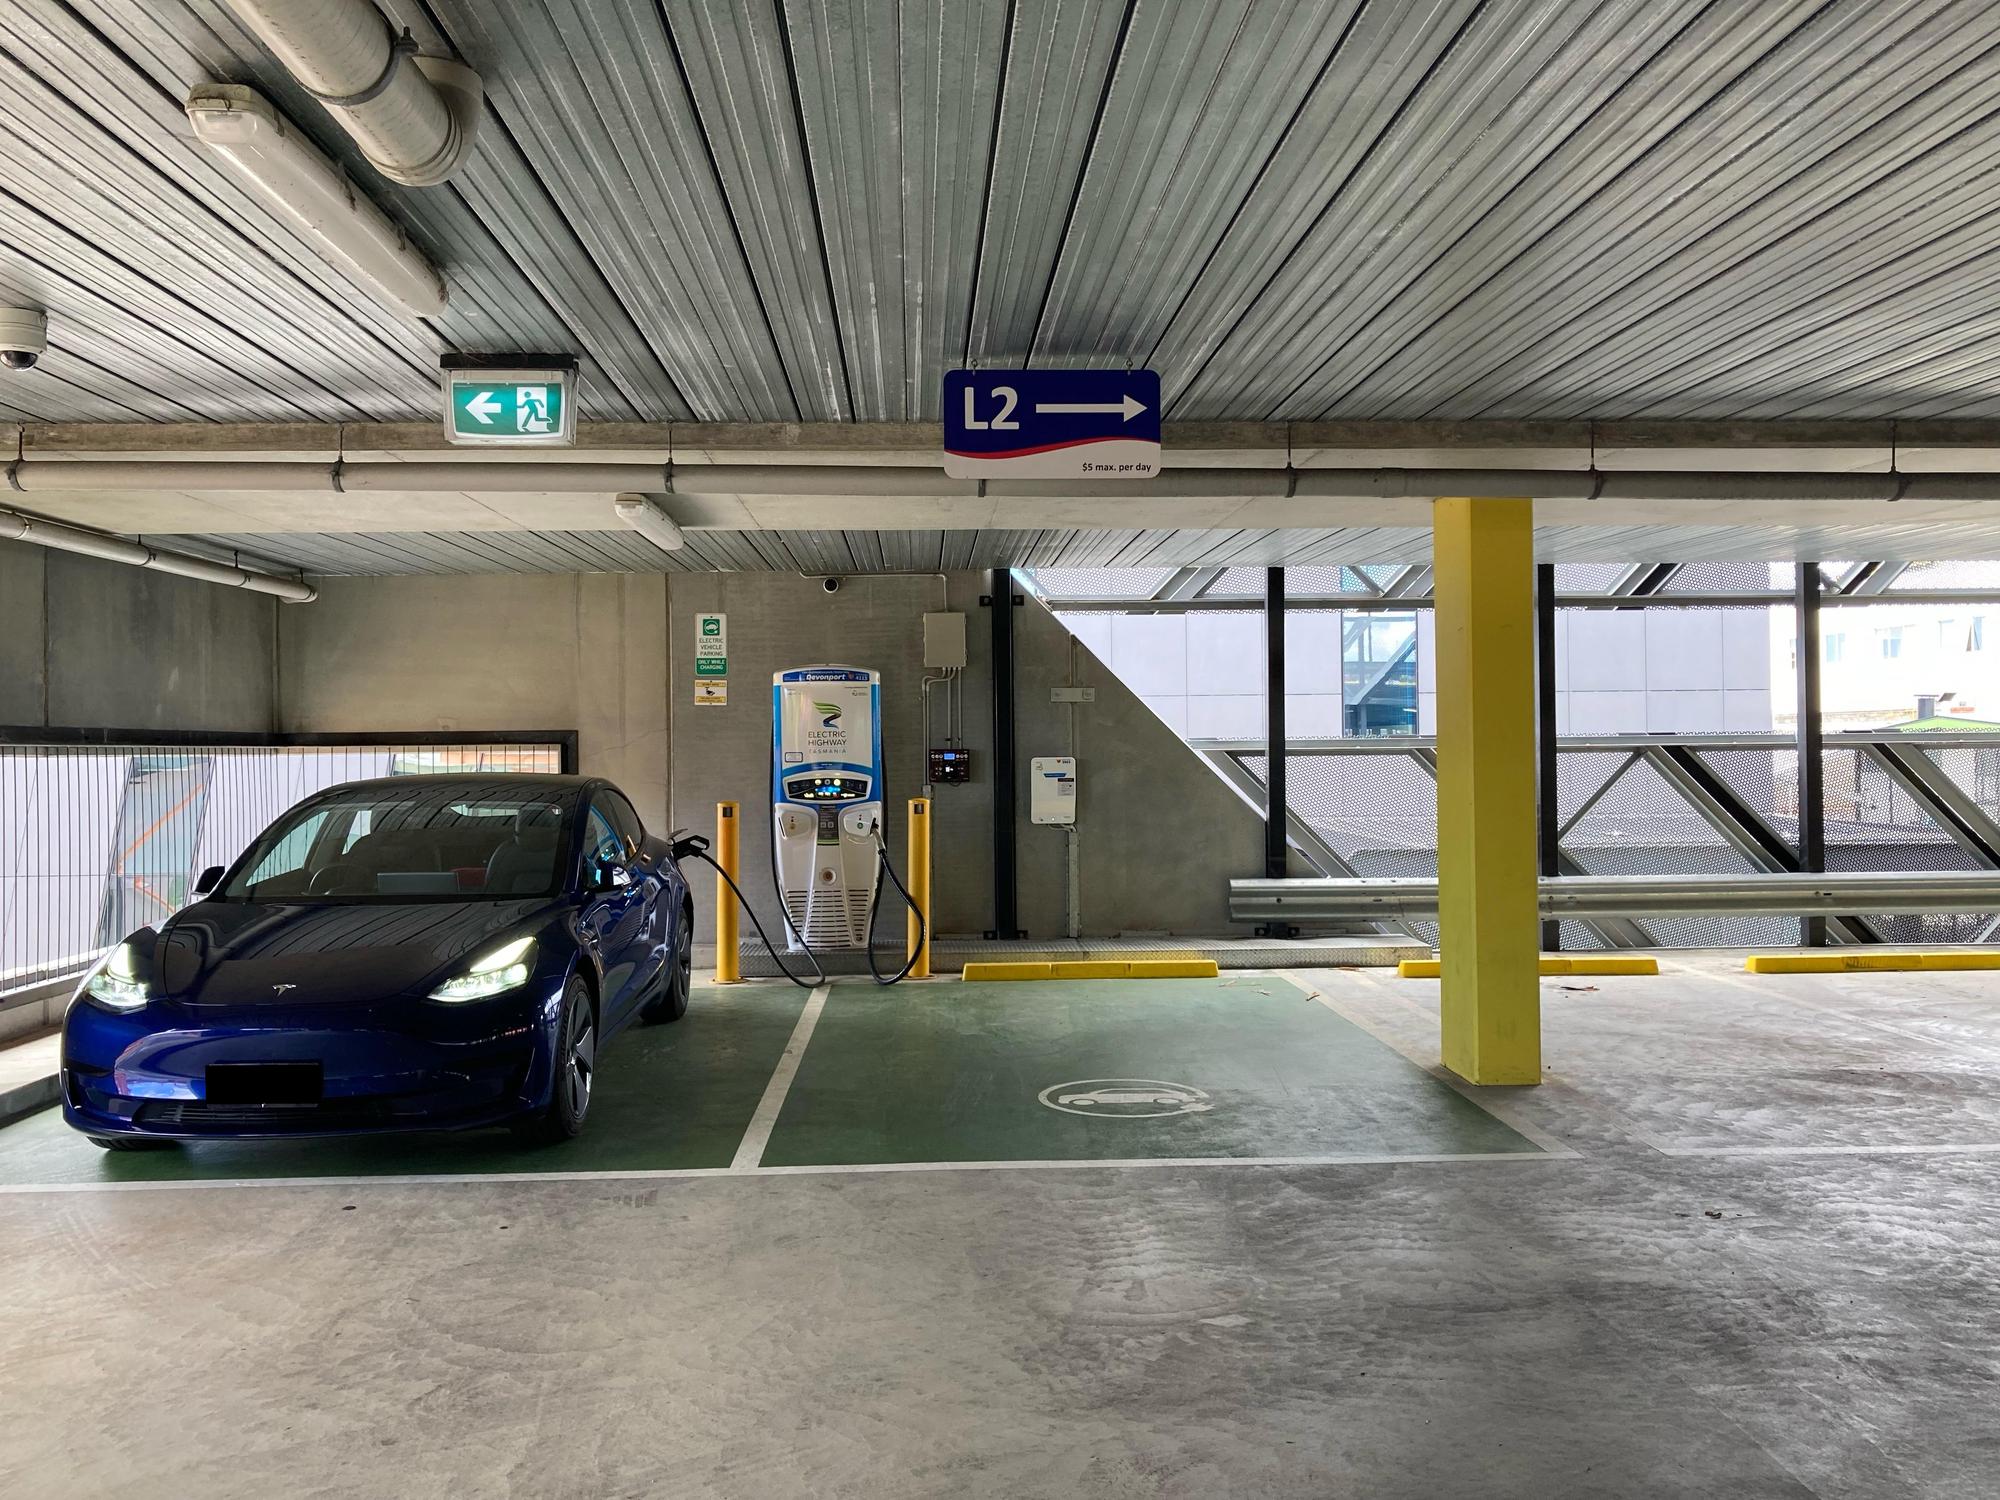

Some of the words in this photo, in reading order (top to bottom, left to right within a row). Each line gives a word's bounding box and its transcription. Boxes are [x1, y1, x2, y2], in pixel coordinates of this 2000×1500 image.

[964, 386, 1020, 430] L2
[1082, 463, 1093, 472] $5
[1095, 464, 1117, 472] max.
[1118, 464, 1133, 474] per
[1135, 463, 1151, 474] day
[806, 673, 846, 681] Devonport
[808, 730, 846, 738] ELECTRIC
